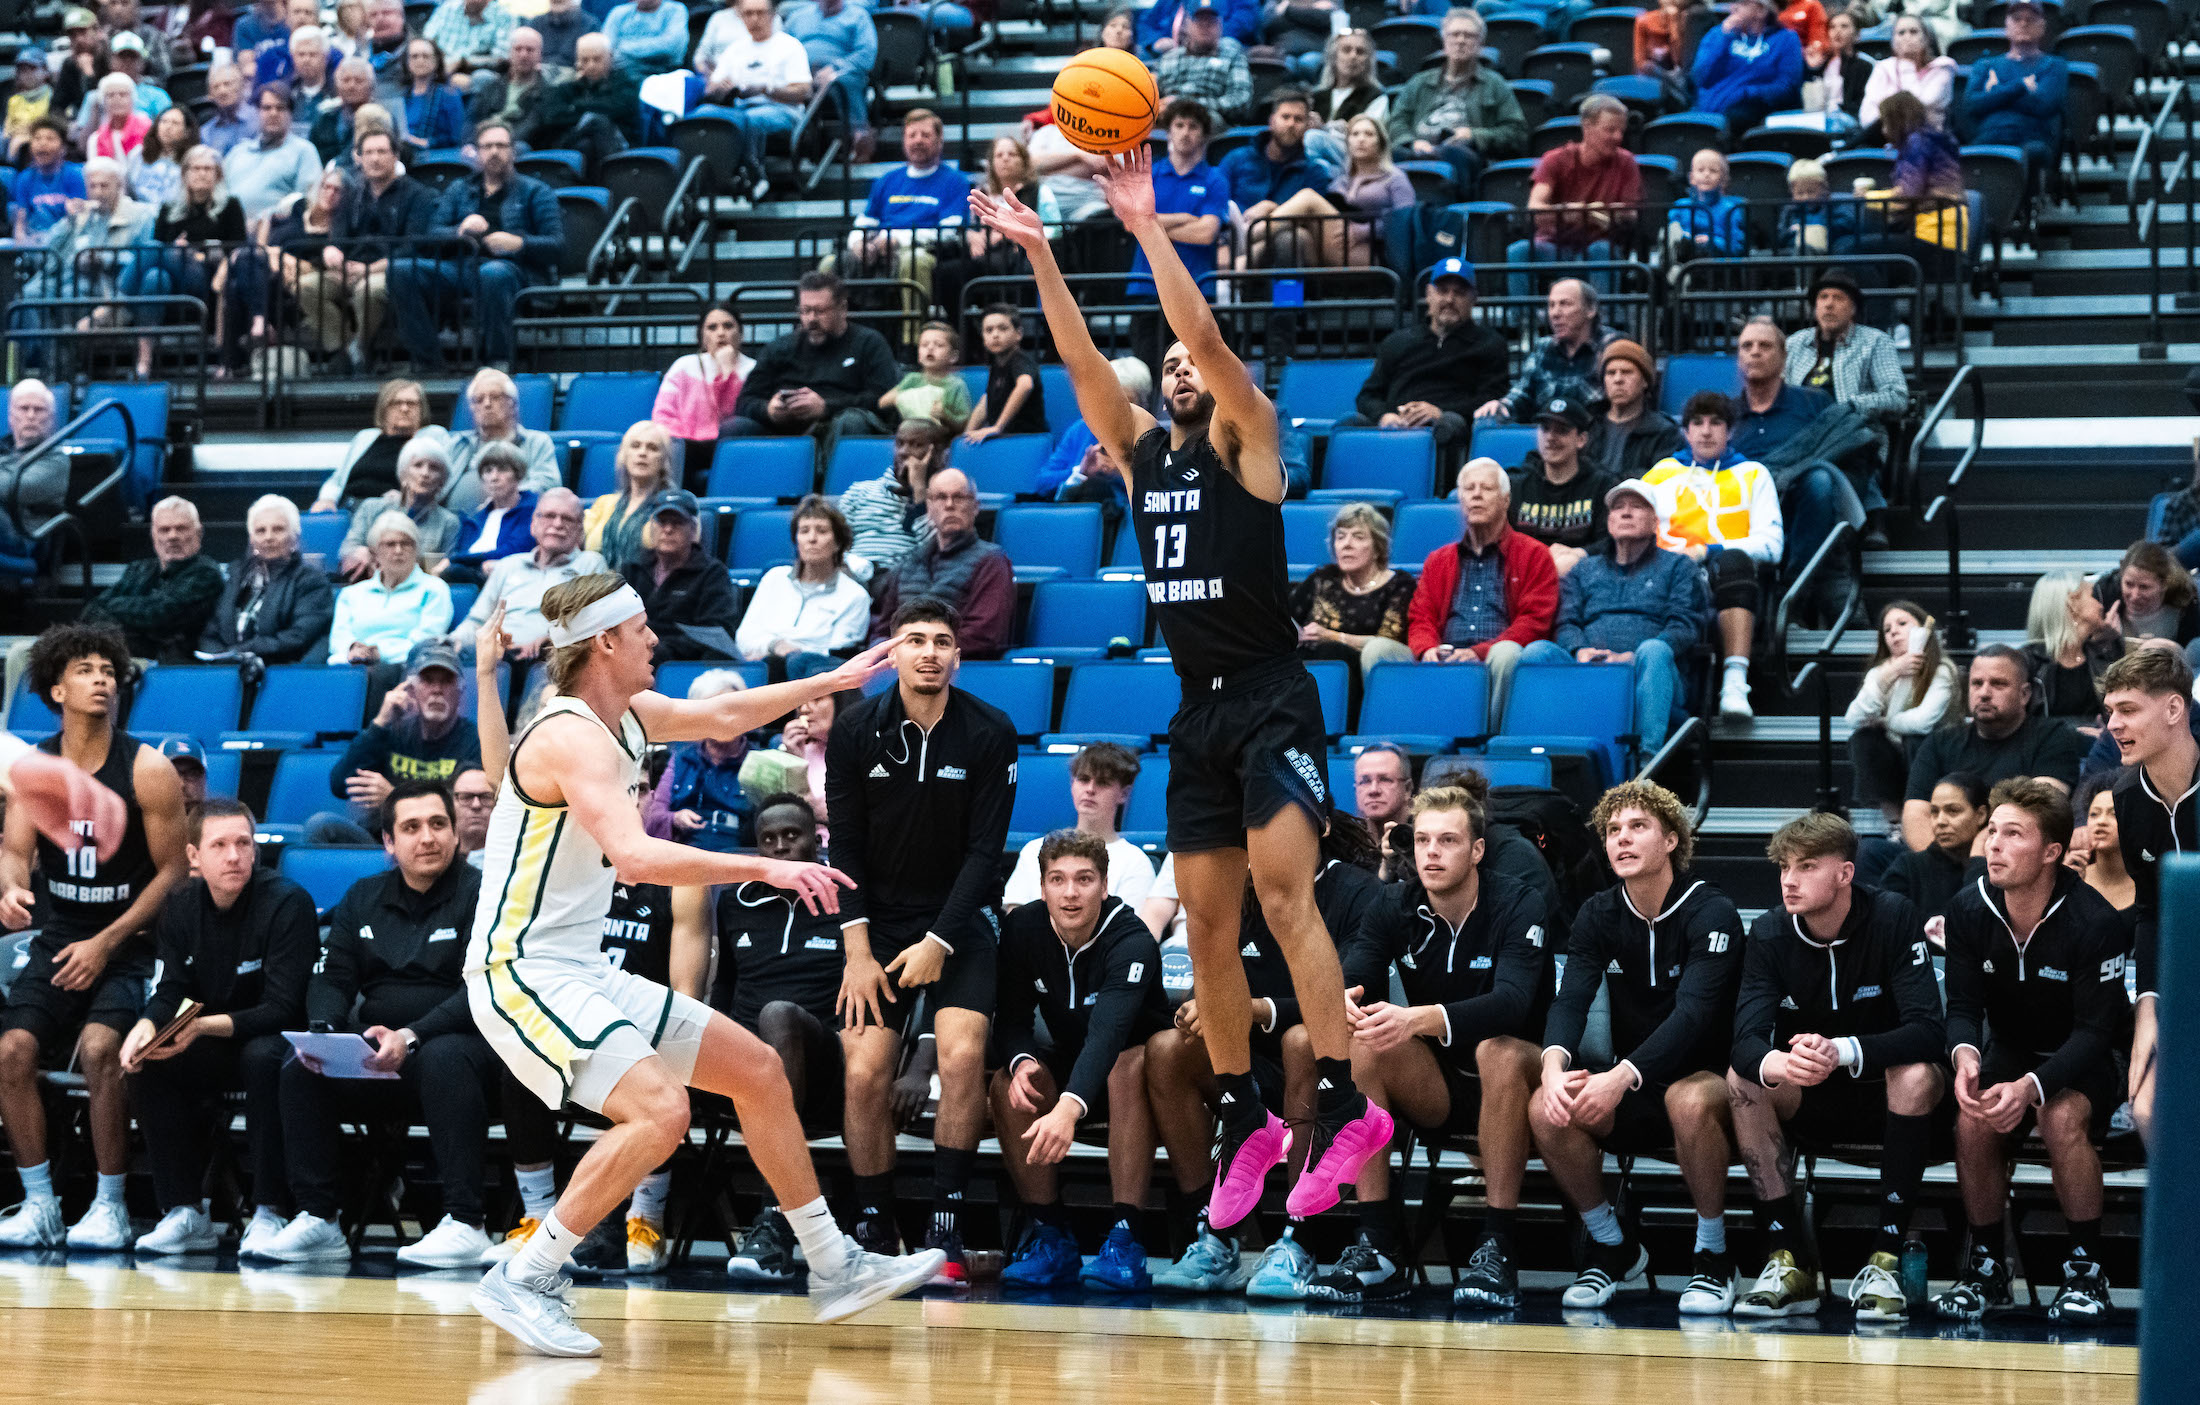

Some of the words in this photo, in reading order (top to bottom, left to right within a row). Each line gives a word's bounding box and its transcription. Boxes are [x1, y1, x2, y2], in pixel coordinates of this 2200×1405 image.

[1057, 103, 1120, 138] Wilson
[1143, 489, 1201, 513] SANTA
[1154, 524, 1187, 569] 13
[1145, 578, 1224, 603] ARBARA
[65, 845, 97, 879] 10
[48, 880, 130, 903] BARBARA
[602, 917, 650, 942] ANTA
[1127, 962, 1144, 983] 8
[2100, 953, 2125, 983] 99
